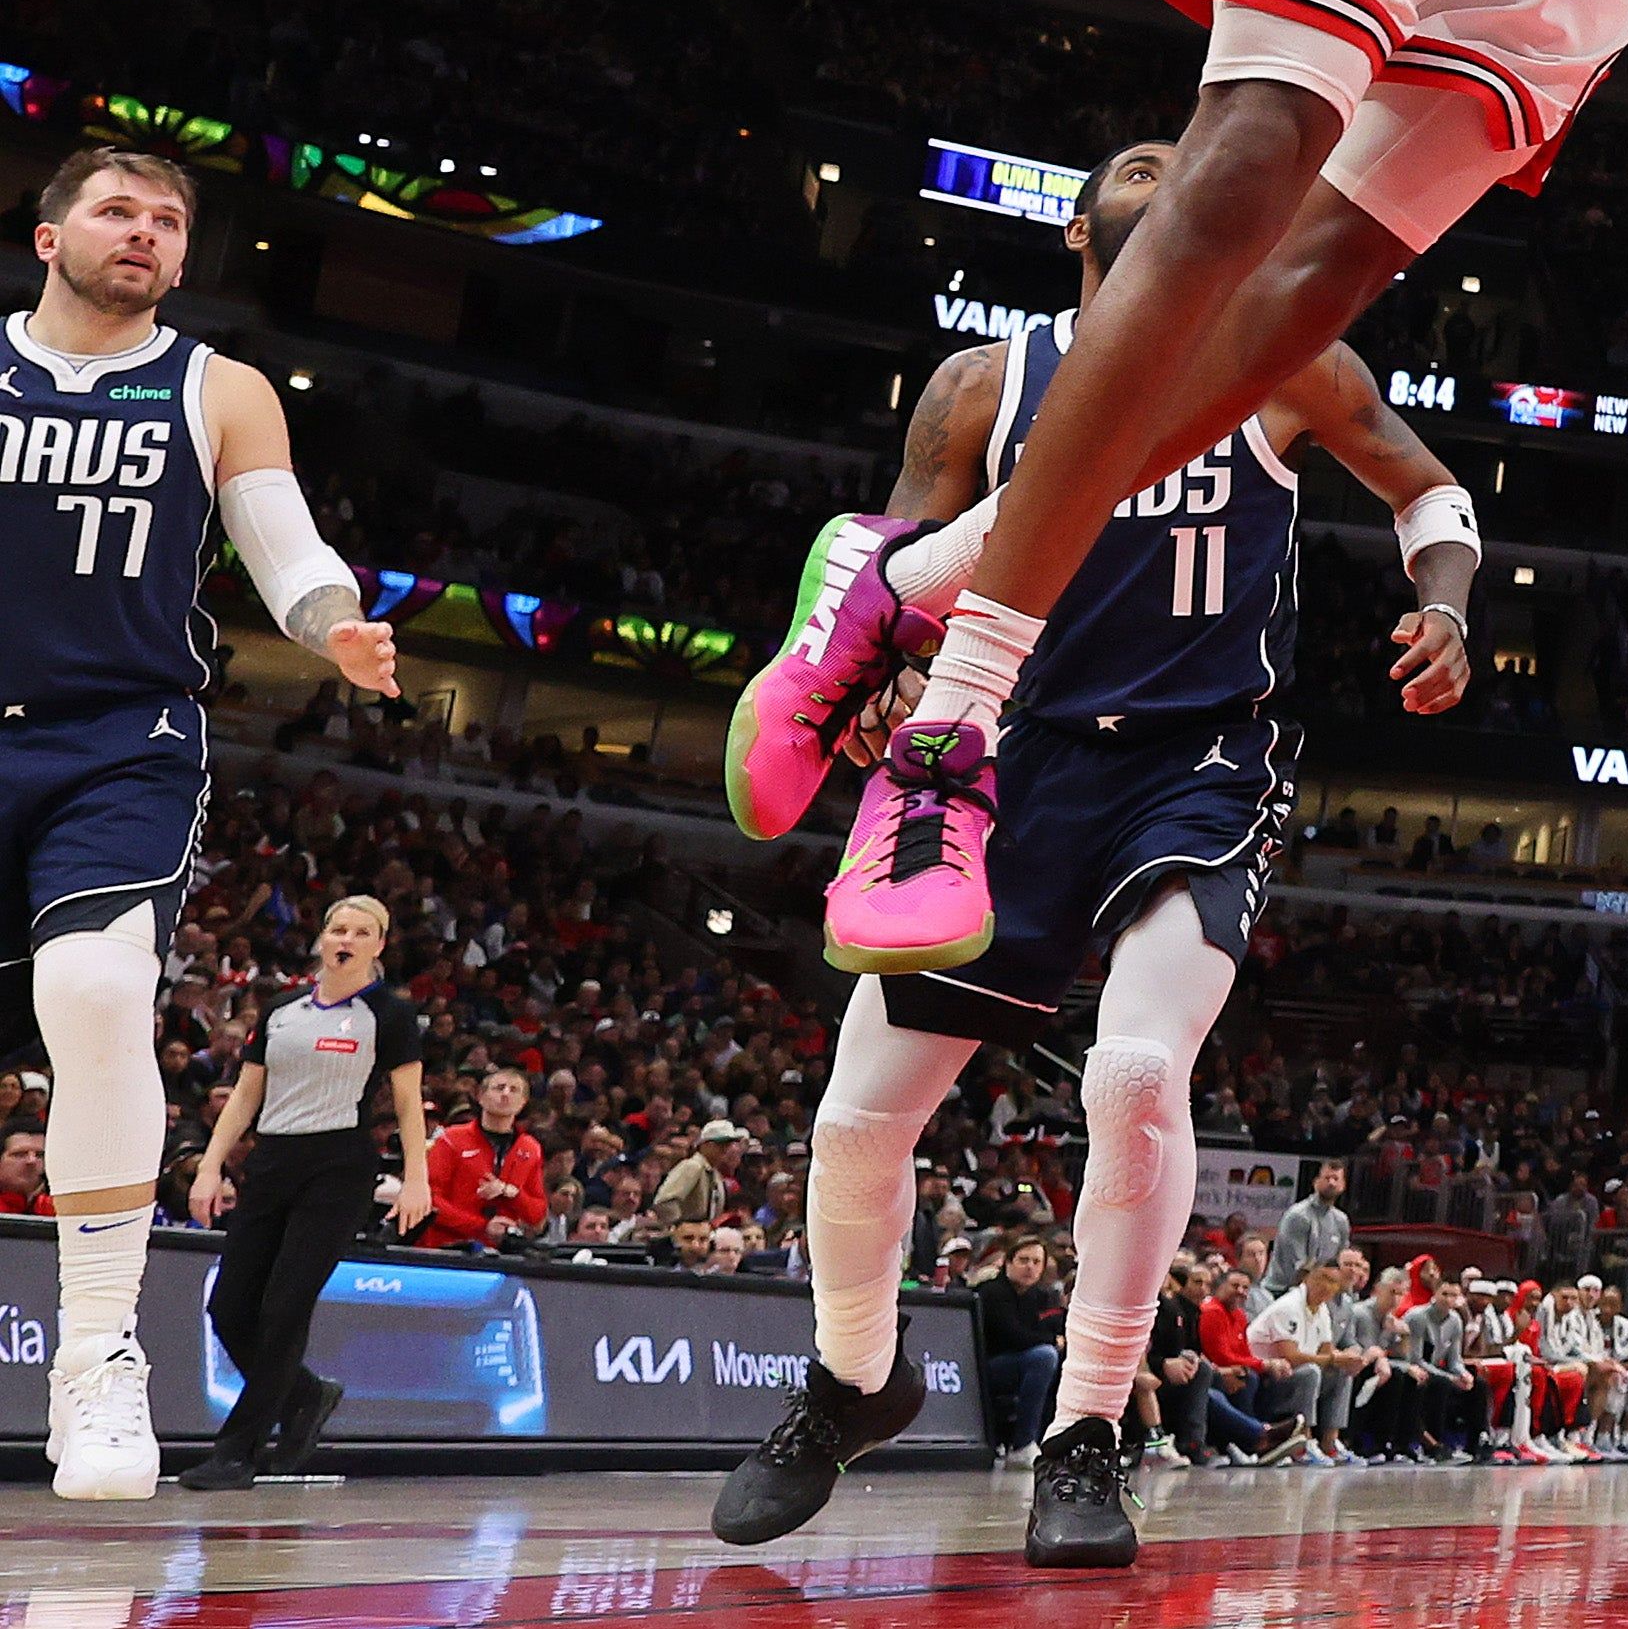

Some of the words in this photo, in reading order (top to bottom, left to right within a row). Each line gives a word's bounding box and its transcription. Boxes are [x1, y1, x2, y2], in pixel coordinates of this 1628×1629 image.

[109, 384, 172, 401] chime
[1389, 370, 1456, 412] 8:44
[1596, 395, 1628, 415] NEW
[1594, 414, 1626, 436] NEW
[56, 495, 153, 578] 77
[791, 520, 886, 666] NIKE
[1169, 525, 1226, 616] 11
[595, 1334, 693, 1385] KIA
